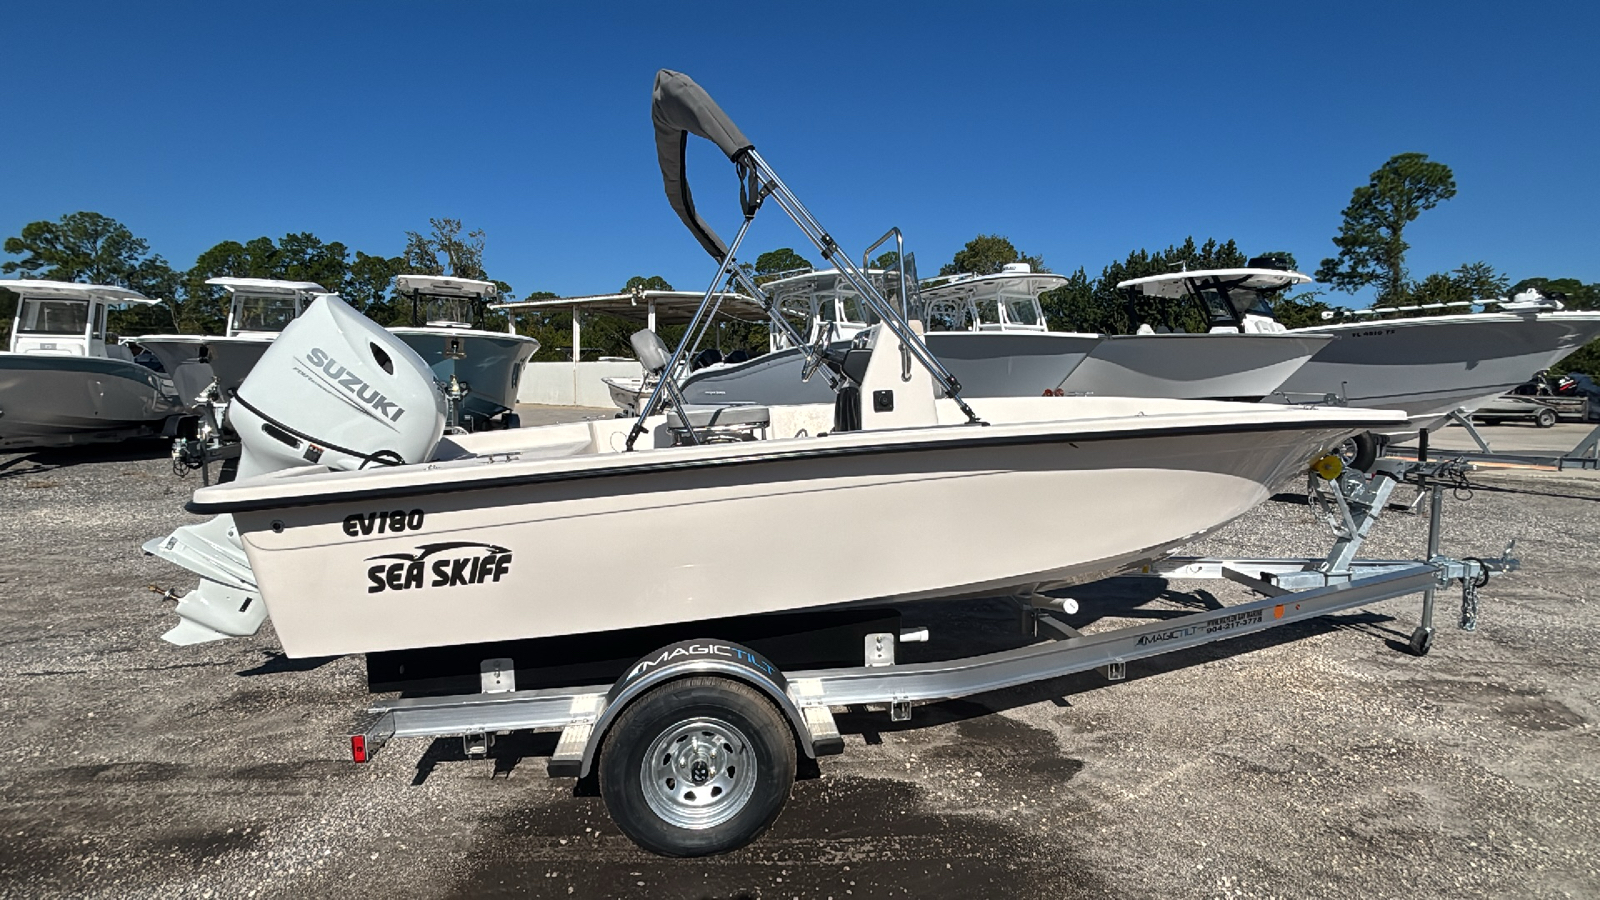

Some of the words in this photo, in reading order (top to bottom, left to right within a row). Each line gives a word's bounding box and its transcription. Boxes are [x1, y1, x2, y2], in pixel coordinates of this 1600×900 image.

[306, 347, 405, 423] SUZUKI
[343, 508, 425, 537] EV180
[367, 561, 425, 594] SEA
[431, 553, 513, 587] SKIFF
[642, 644, 775, 676] MAGICTILT
